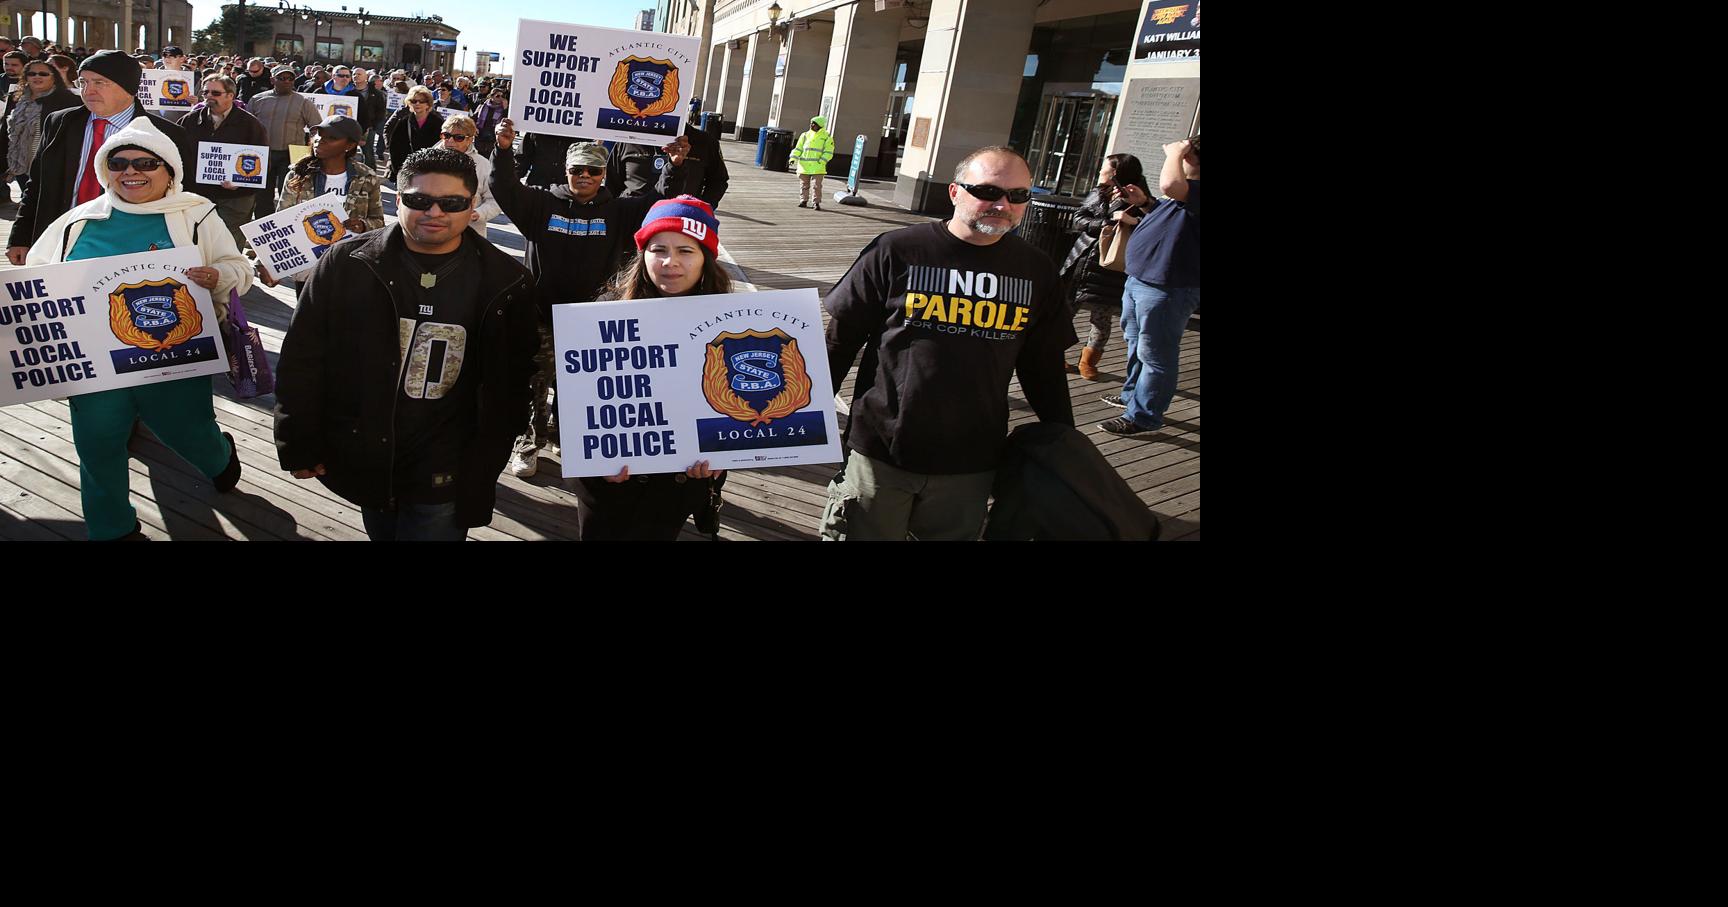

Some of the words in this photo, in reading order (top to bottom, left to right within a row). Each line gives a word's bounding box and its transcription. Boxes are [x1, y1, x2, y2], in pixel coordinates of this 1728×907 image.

[550, 33, 577, 52] WE
[1143, 33, 1166, 43] KATT
[522, 49, 600, 73] SUPPORT
[608, 42, 663, 58] ATLANTIC
[667, 47, 691, 64] CITY
[1146, 49, 1192, 59] JANUARY
[540, 70, 577, 89] OUR
[529, 88, 582, 109] LOCAL
[523, 105, 583, 127] POLICE
[610, 117, 648, 127] LOCAL
[200, 152, 231, 161] SUPPORT
[252, 224, 296, 247] SUPPORT
[259, 219, 277, 233] WE
[268, 238, 292, 252] OUR
[270, 246, 302, 263] LOCAL
[273, 254, 309, 273] POLICE
[92, 263, 156, 292] ATLANTIC
[163, 264, 188, 274] CIT
[948, 269, 998, 299] NO
[5, 278, 49, 301] WE
[0, 296, 86, 325] UPPORT
[135, 298, 148, 306] NEW
[140, 307, 167, 317] STATE
[905, 292, 1030, 331] PAROLE
[143, 318, 174, 327] P.B.A.
[598, 318, 641, 344] WE
[688, 308, 763, 341] ATLANTIC
[771, 310, 811, 332] CITY
[904, 319, 932, 329] FOR
[936, 324, 967, 335] COP
[15, 321, 68, 345] OUR
[9, 341, 86, 368] LOCAL
[128, 351, 179, 365] LOCAL
[186, 349, 201, 359] 24
[564, 343, 679, 374] SUPPORT
[735, 353, 749, 361] NEW
[750, 352, 776, 360] JERSEY
[12, 361, 97, 390] POLICE
[740, 363, 770, 379] STATE
[597, 374, 652, 400] OUR
[740, 381, 777, 390] P.B.A.
[586, 402, 669, 430] LOCAL
[718, 429, 778, 441] LOCAL
[787, 424, 807, 436] 24
[583, 430, 677, 460] POLICE
